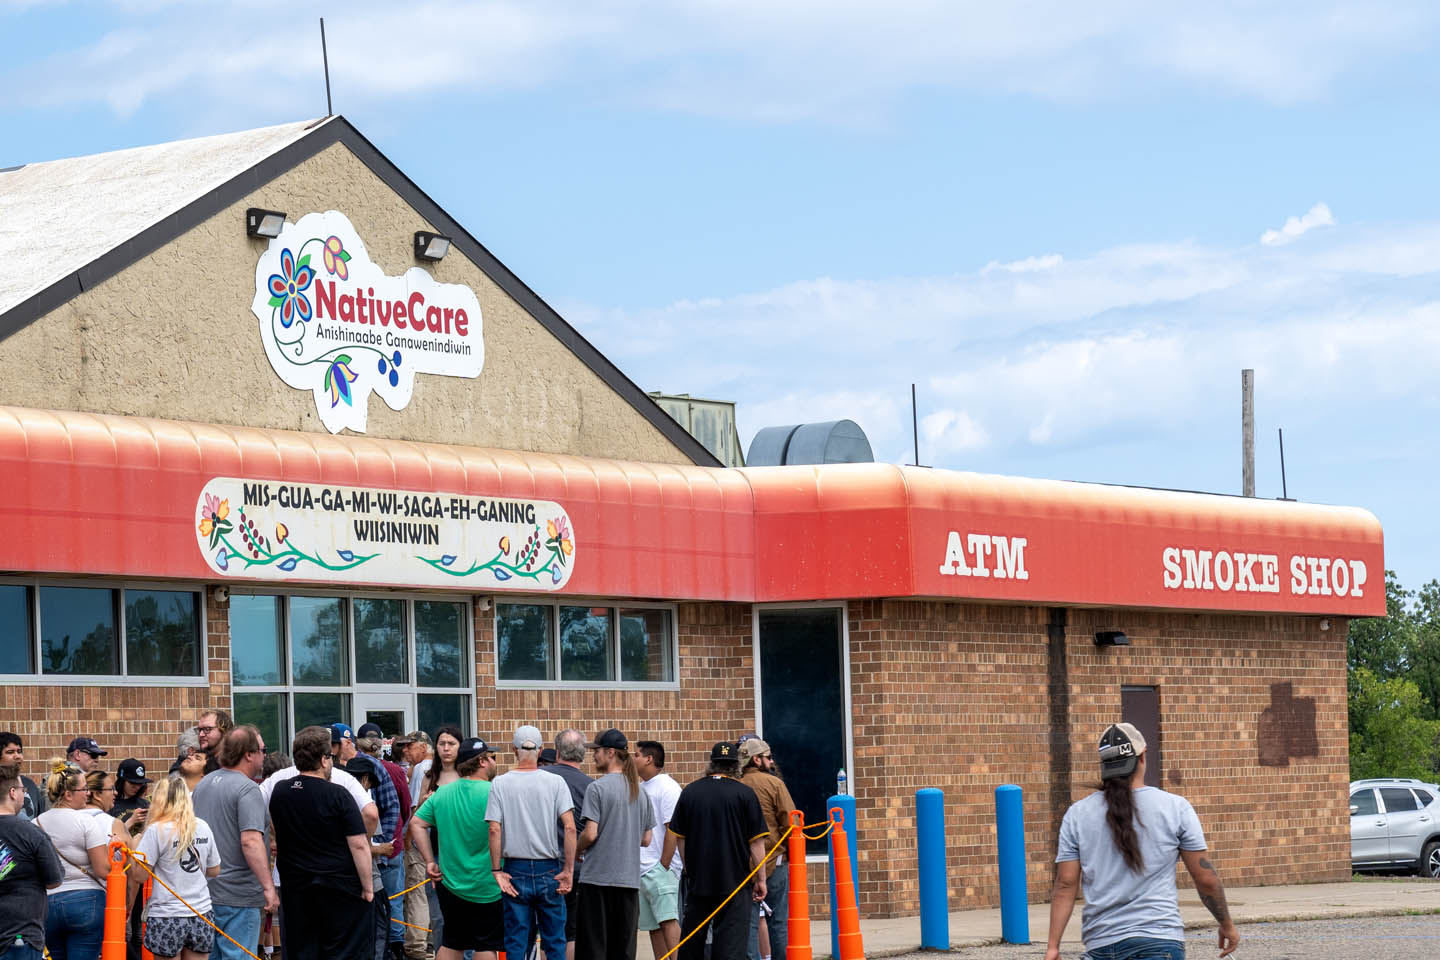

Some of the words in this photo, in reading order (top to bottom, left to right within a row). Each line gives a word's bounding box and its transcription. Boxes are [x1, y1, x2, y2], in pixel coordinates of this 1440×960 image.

[315, 279, 469, 337] NativeCare
[316, 323, 382, 346] Anishinaabe
[386, 331, 471, 356] Ganawenindiwin
[354, 519, 440, 546] WIISINIWIN
[939, 531, 1029, 581] ATM
[1163, 546, 1280, 593] SMOKE
[1290, 555, 1367, 597] SHOP
